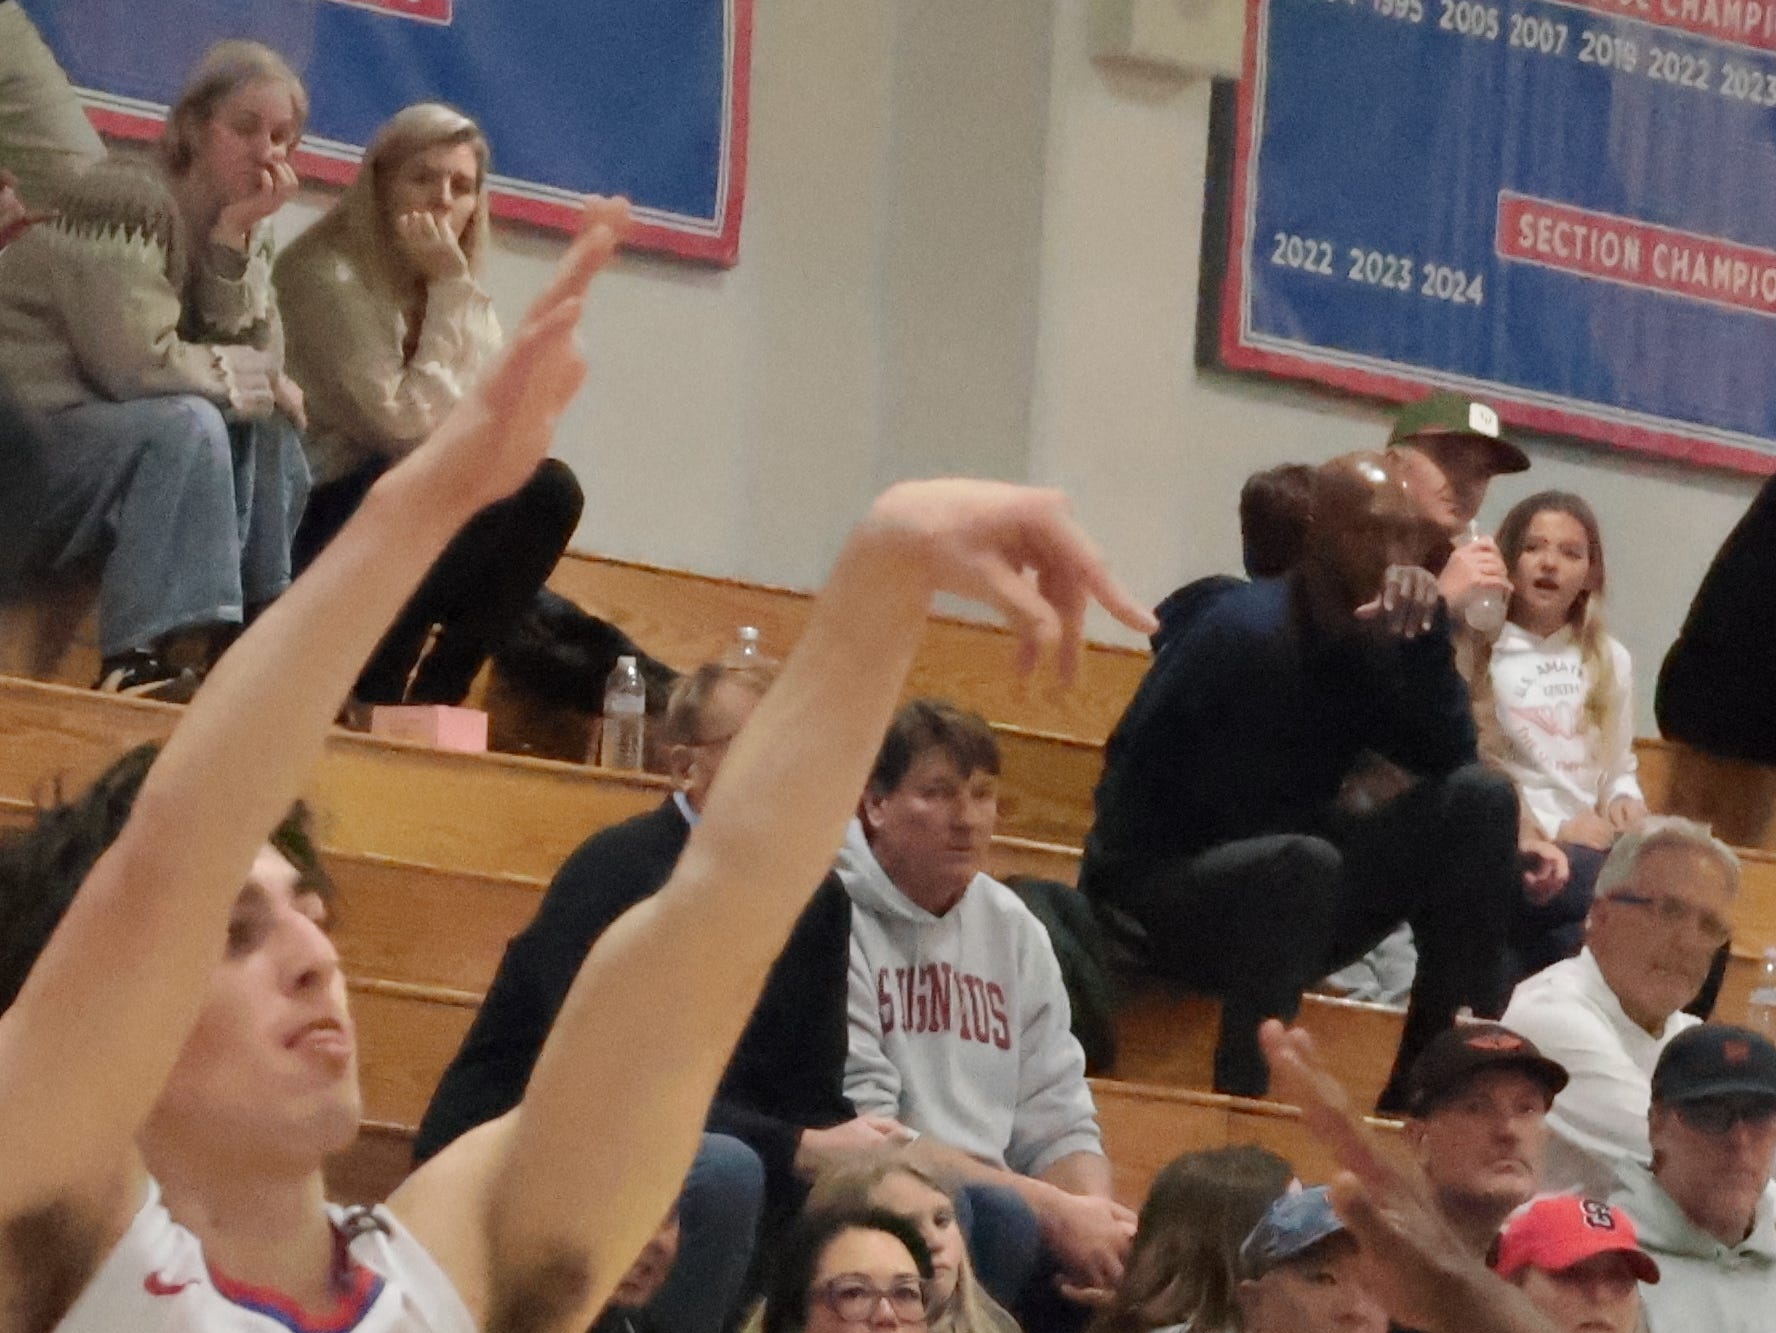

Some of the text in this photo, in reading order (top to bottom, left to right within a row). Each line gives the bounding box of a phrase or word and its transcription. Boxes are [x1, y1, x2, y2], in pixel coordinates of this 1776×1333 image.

[1440, 0, 1500, 40] 2005
[1509, 14, 1569, 54] 2007
[1647, 49, 1711, 90] 2022
[1272, 231, 1484, 306] 2022 2023 2024
[1518, 213, 1641, 269] SECTION
